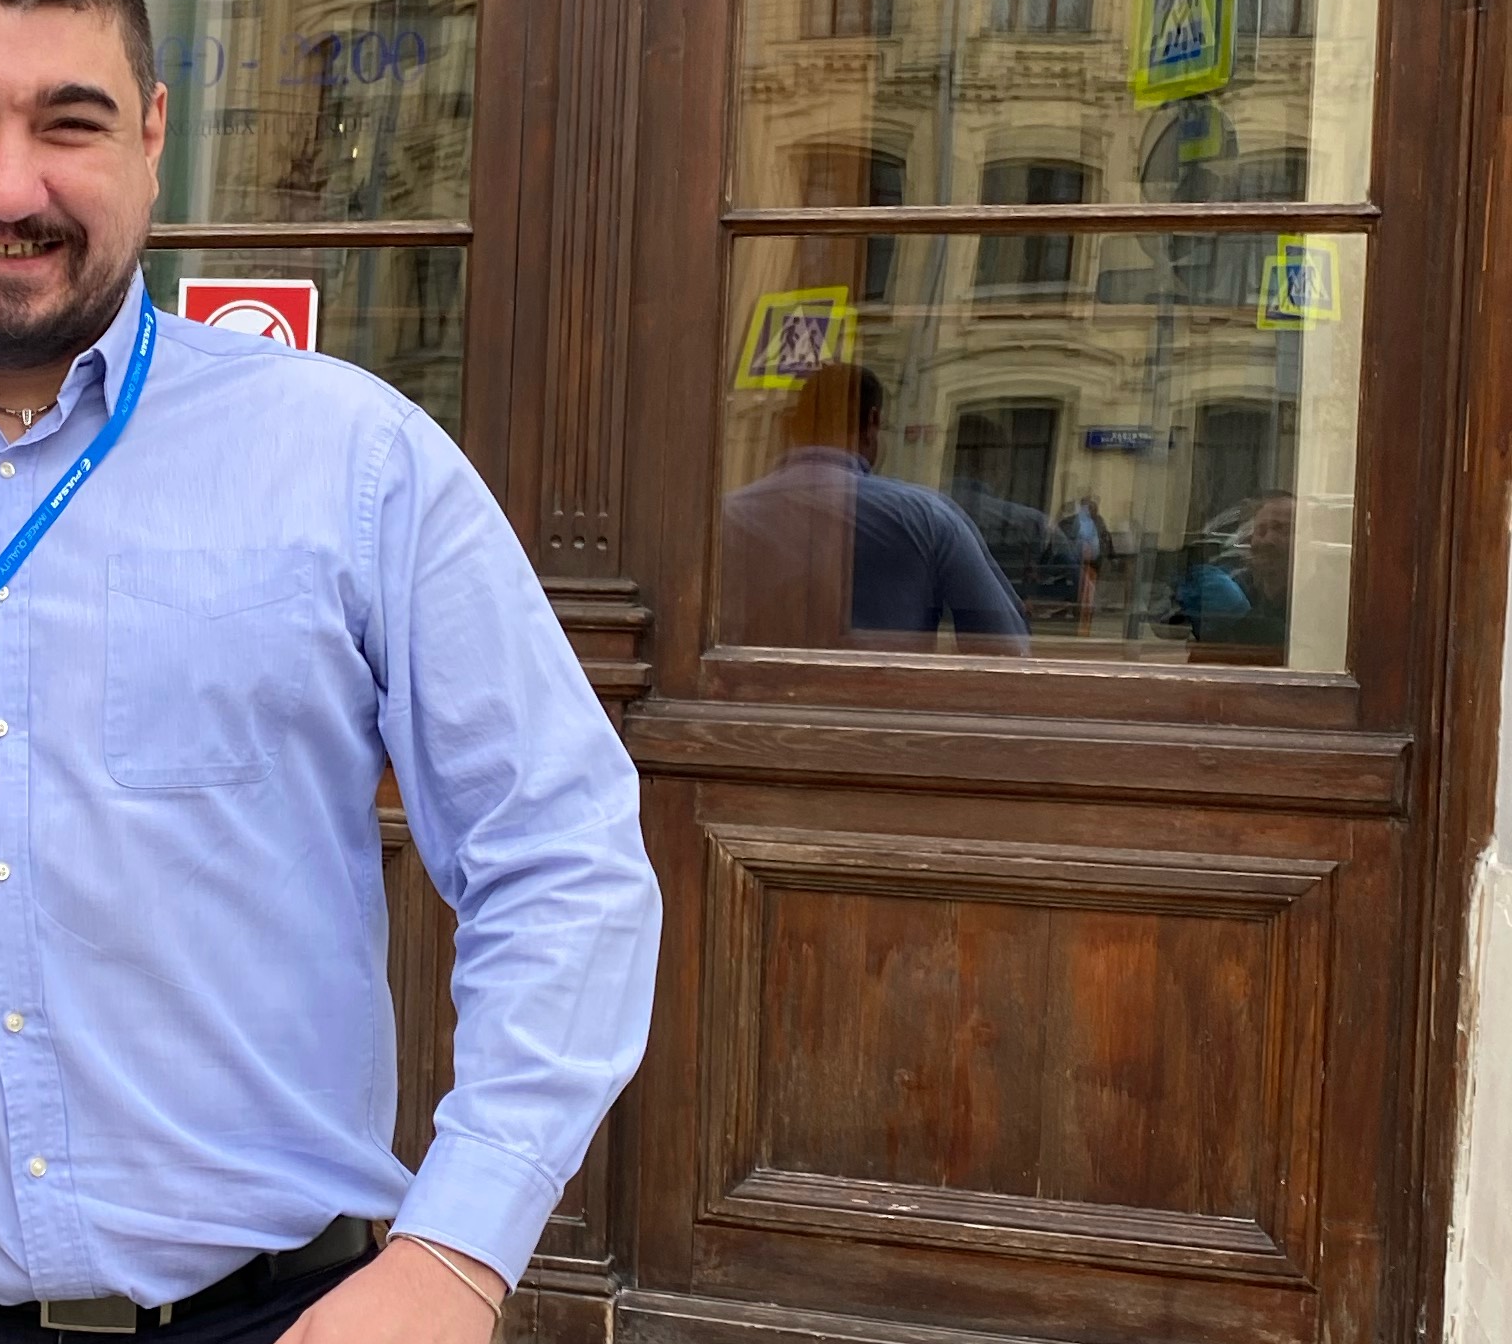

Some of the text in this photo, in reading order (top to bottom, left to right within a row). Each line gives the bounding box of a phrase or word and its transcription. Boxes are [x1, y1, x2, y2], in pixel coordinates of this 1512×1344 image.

[278, 30, 428, 87] 22.00
[0, 469, 83, 575] PULSAR IMAGE QUALITY
